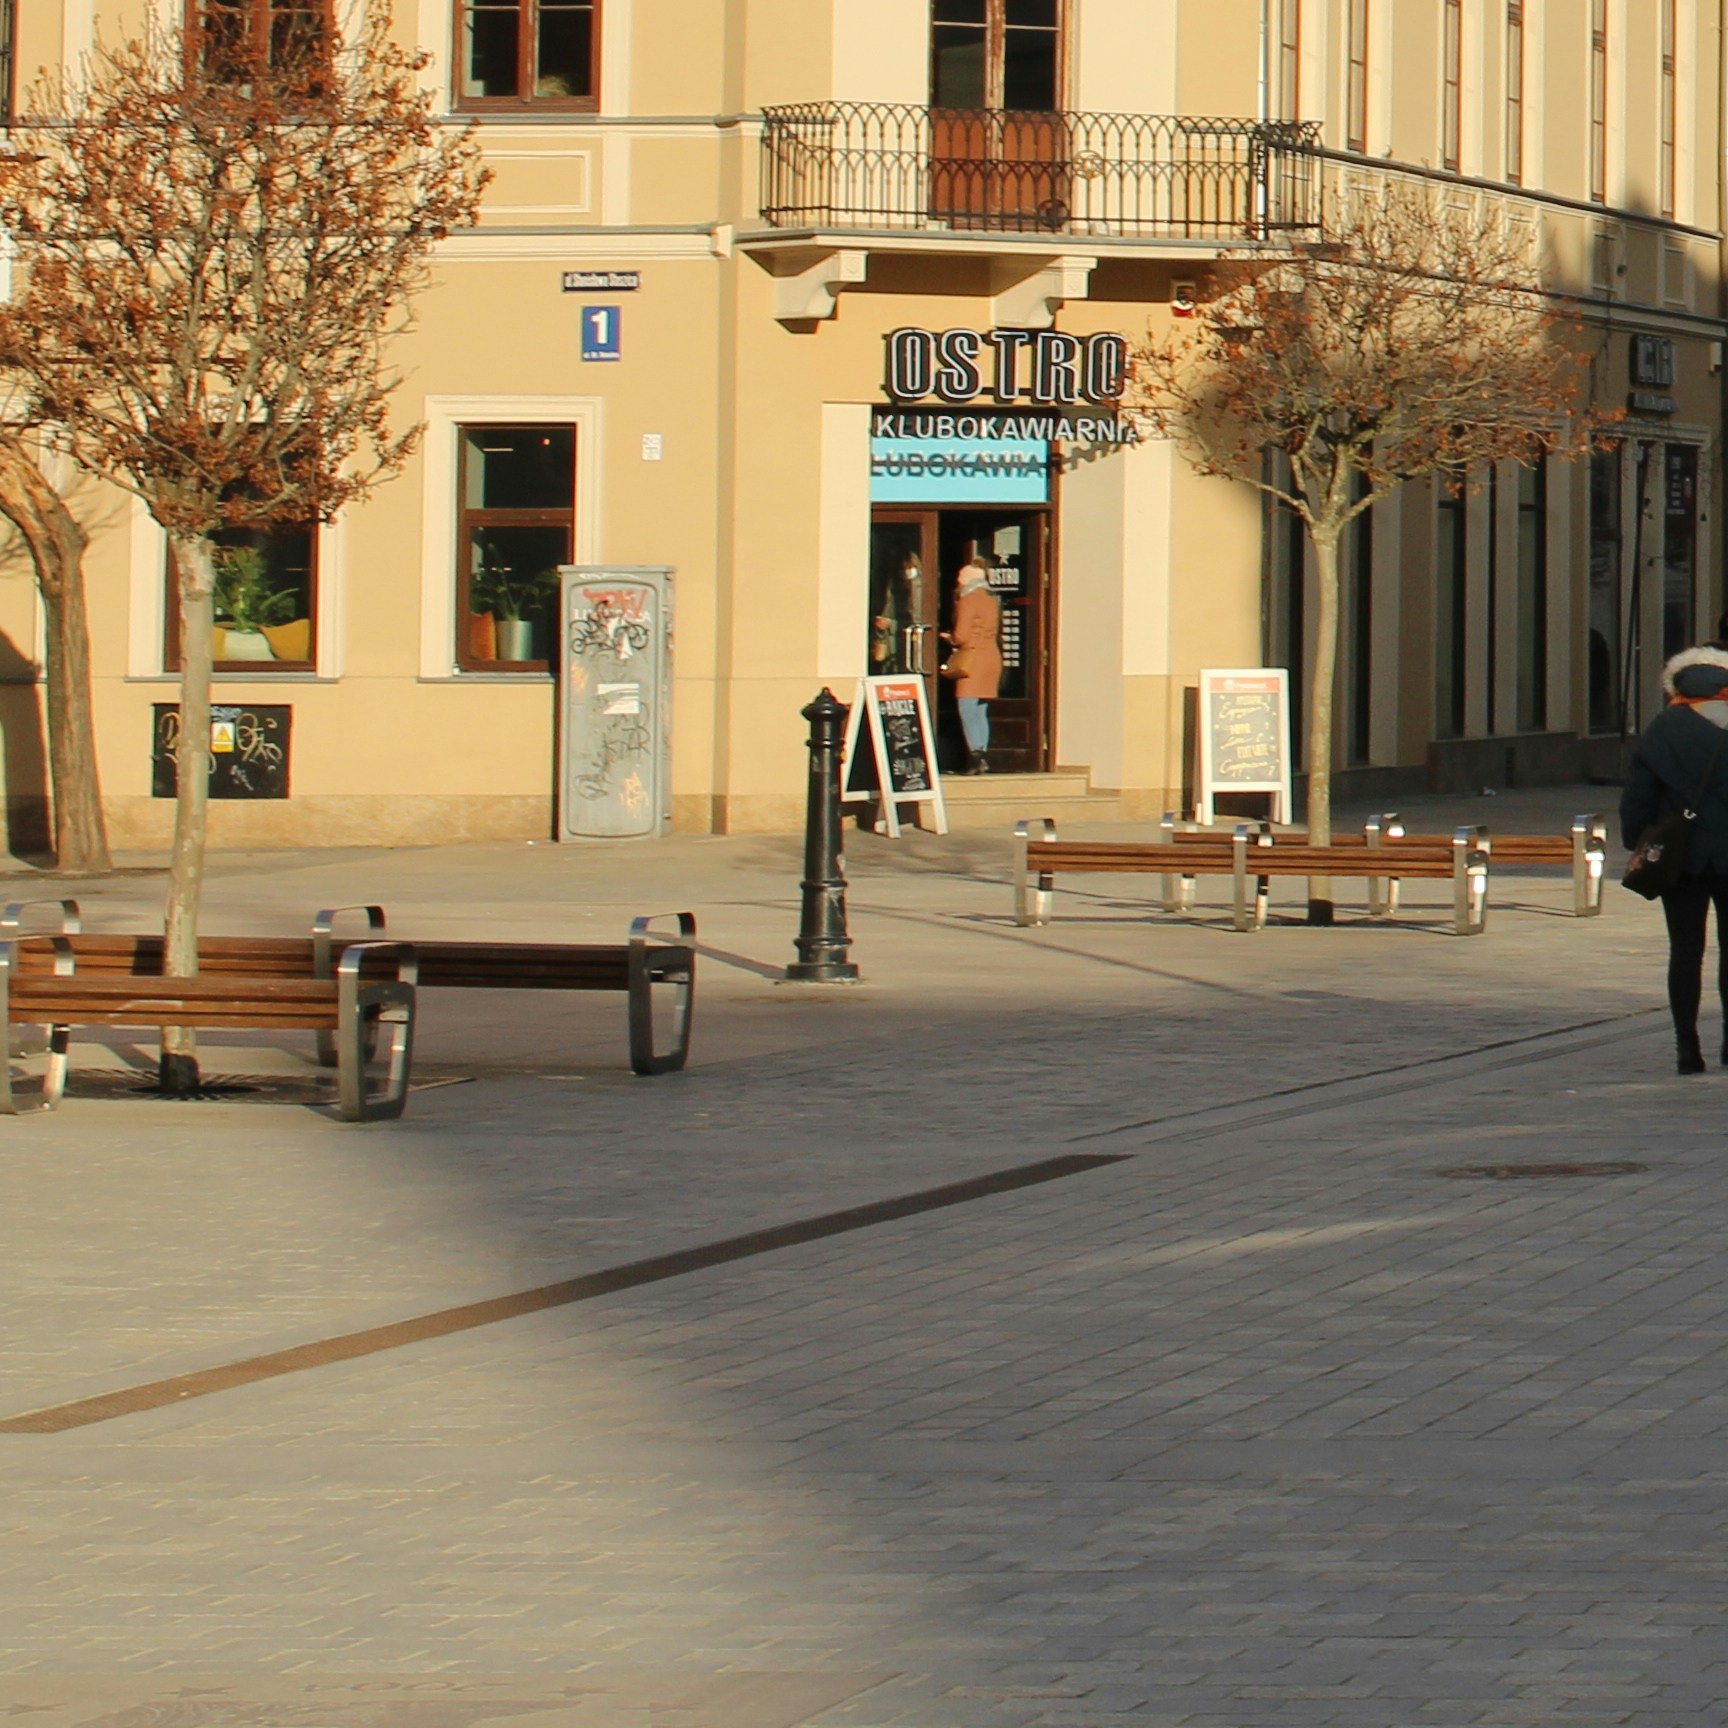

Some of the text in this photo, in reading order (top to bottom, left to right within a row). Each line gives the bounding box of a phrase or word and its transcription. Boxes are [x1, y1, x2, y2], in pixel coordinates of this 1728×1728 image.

[591, 309, 609, 345] 1
[888, 327, 1129, 403] OSTRO
[988, 567, 1020, 585] OSTRO
